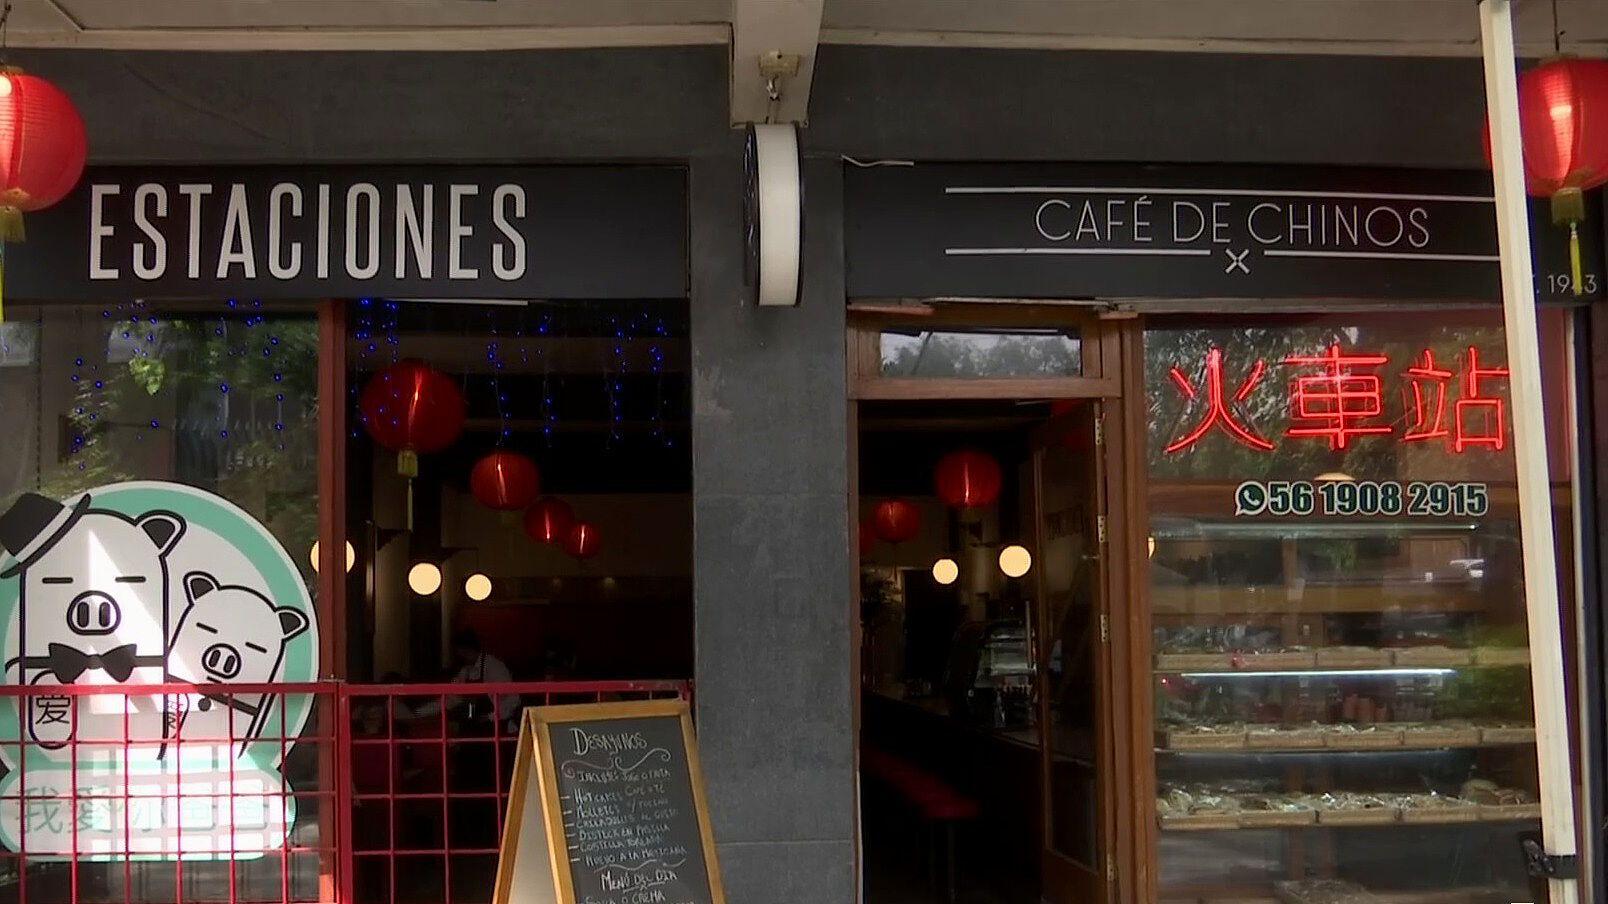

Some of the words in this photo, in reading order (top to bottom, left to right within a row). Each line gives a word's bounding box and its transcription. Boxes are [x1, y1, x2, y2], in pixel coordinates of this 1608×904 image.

[89, 182, 528, 281] ESTACIONES
[1035, 195, 1153, 242] CAFÉ
[1173, 201, 1232, 243] DE
[1247, 202, 1431, 248] CHINOS
[1547, 273, 1597, 294] 193
[1163, 345, 1510, 454] 火車站
[1266, 481, 1313, 517] 56
[1321, 481, 1402, 517] 1908
[1406, 481, 1488, 517] 2915
